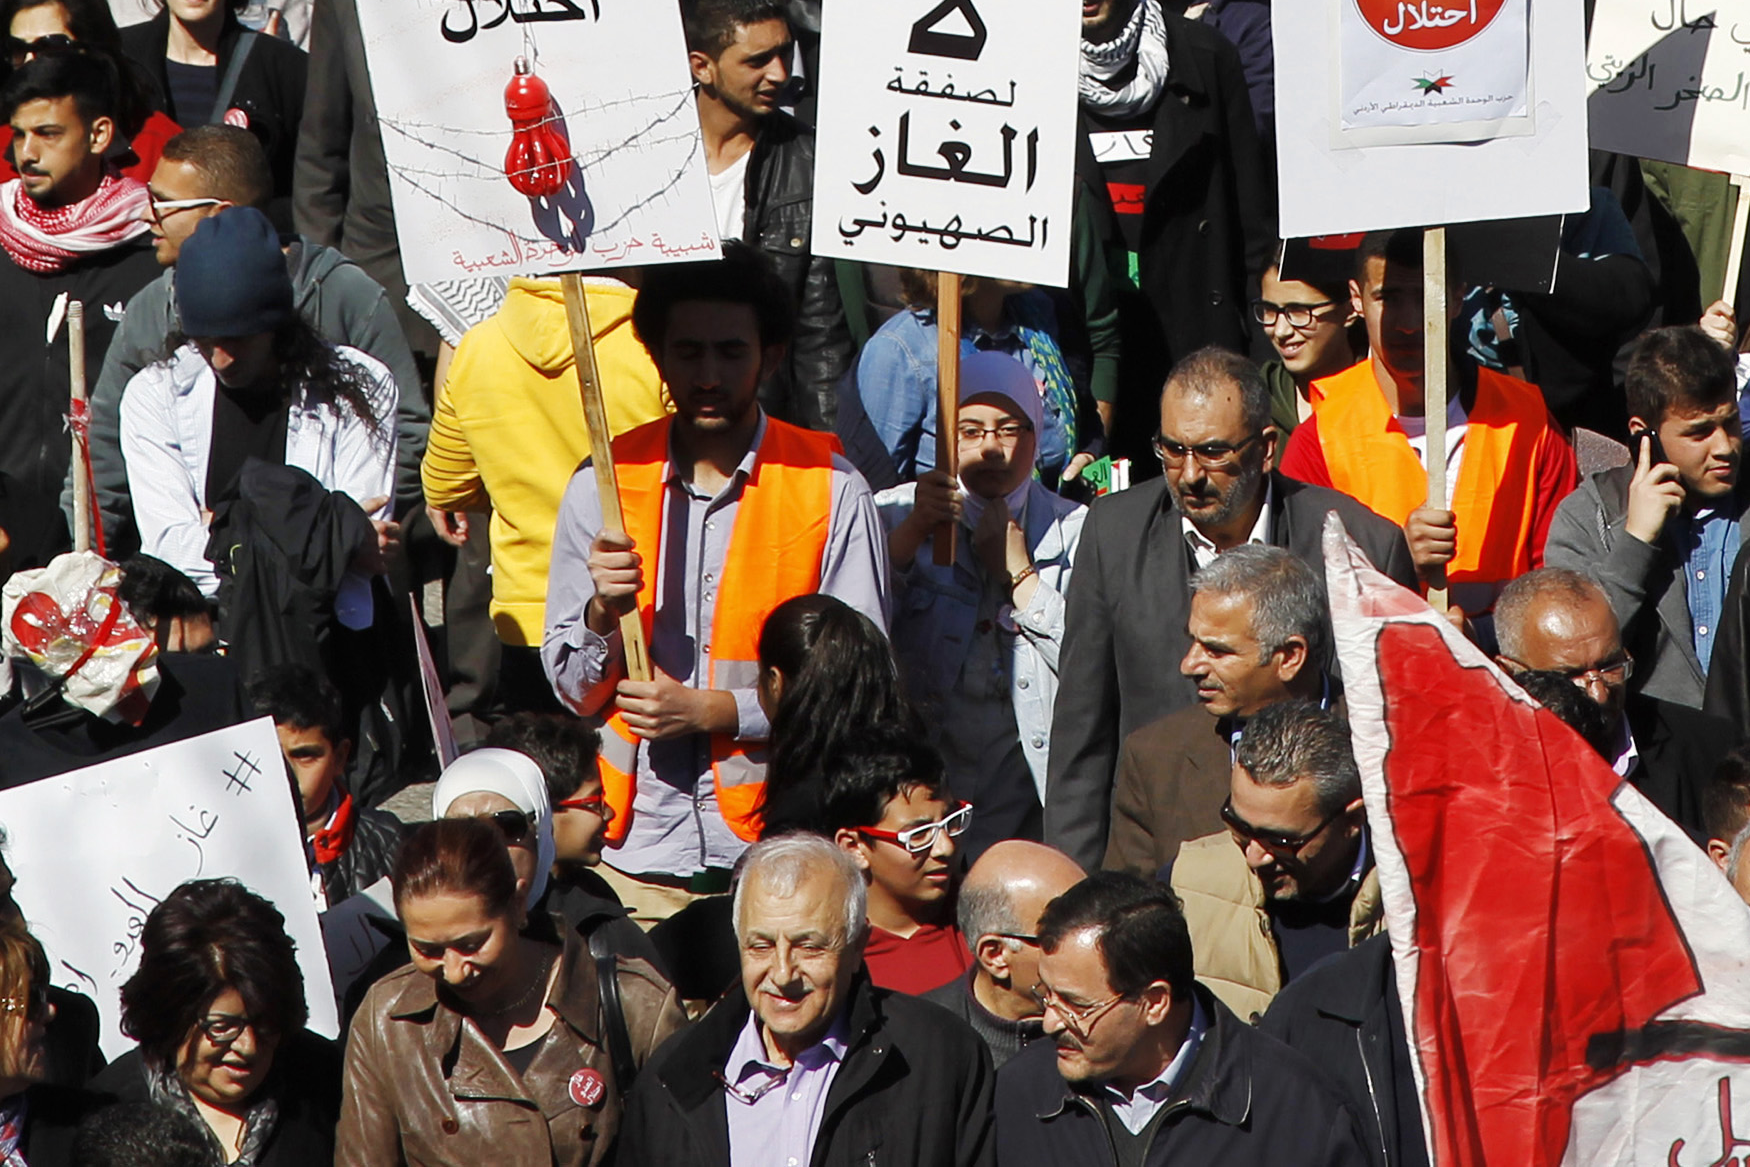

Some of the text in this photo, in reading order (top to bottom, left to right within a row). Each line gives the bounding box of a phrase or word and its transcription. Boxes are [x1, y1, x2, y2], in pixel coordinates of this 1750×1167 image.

[886, 65, 1017, 108] لصفقة
[1586, 53, 1655, 93] الزيتي
[1654, 72, 1750, 111] الصخر
[850, 109, 1040, 196] الغاز
[838, 201, 1049, 251] الصهيوني
[592, 236, 644, 264] حزب
[169, 804, 219, 877] غاز
